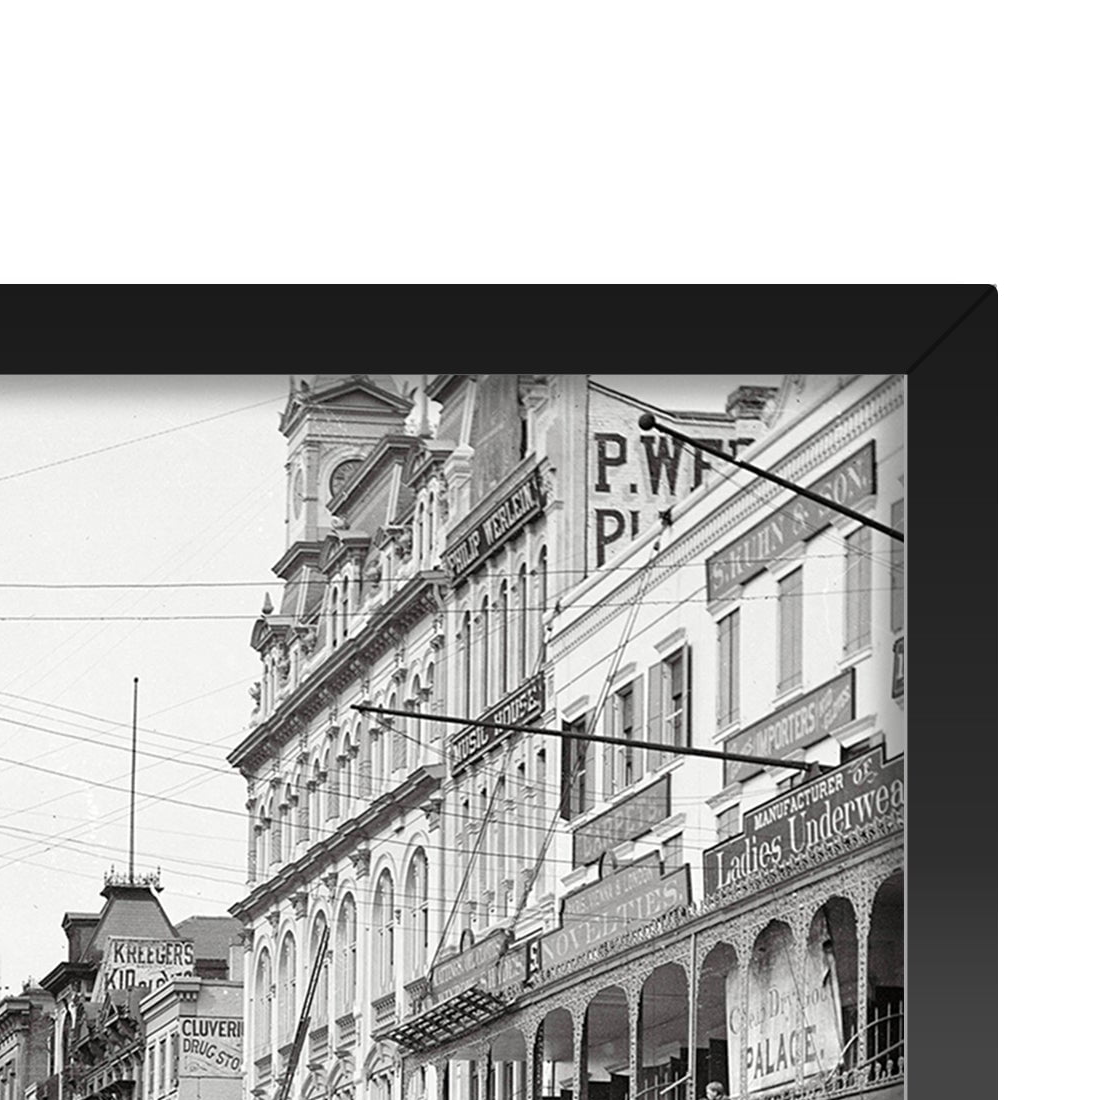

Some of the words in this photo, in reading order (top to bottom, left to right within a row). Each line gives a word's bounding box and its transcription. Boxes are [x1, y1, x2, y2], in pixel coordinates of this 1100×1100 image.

[449, 726, 489, 765] MUSIC
[754, 772, 844, 831] MANUFACTURER
[716, 835, 782, 890] Ladies
[183, 1038, 217, 1059] DRUG
[216, 1051, 241, 1073] STO
